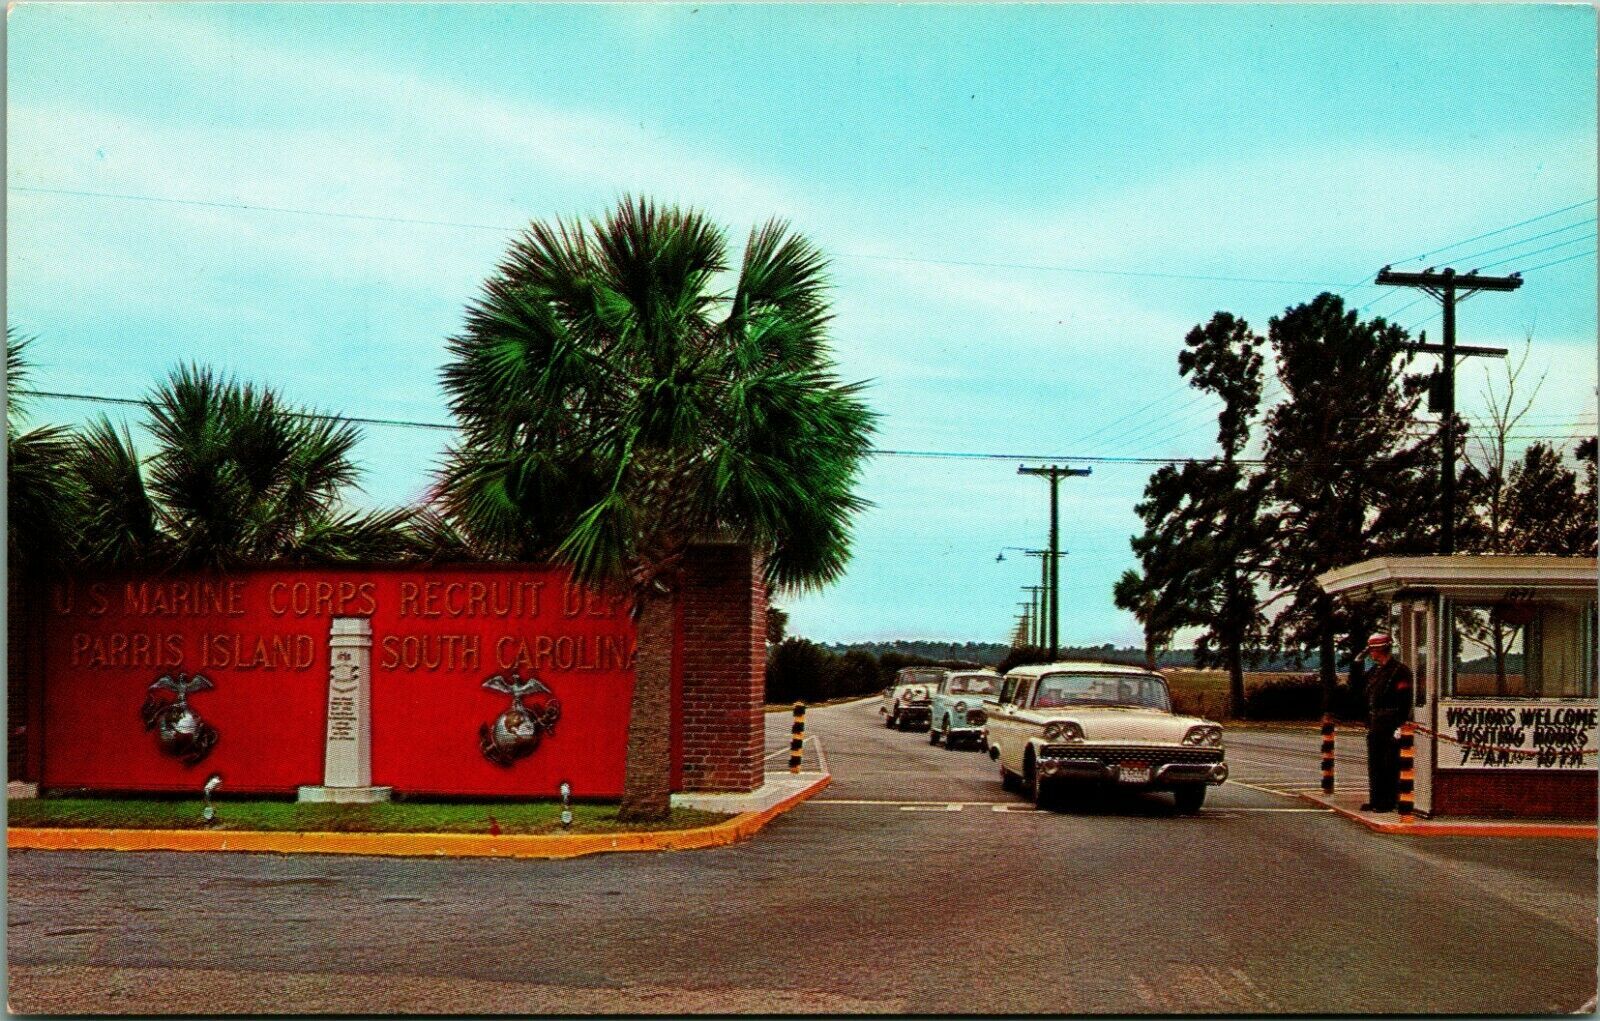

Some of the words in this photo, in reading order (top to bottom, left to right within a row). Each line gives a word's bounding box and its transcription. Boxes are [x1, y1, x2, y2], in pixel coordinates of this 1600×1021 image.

[54, 582, 75, 615] U
[88, 582, 109, 615] S
[124, 581, 247, 616] MARINE
[268, 581, 377, 616] CORPS
[399, 581, 546, 617] RECRUIT
[71, 632, 185, 668] PARRIS
[201, 632, 315, 669] ISLAND
[380, 634, 481, 670] SOUTH
[1446, 706, 1517, 728] VISITORS
[1519, 707, 1599, 730] WELCOME
[1456, 725, 1526, 749] VISITING
[1533, 726, 1589, 749] HOURS
